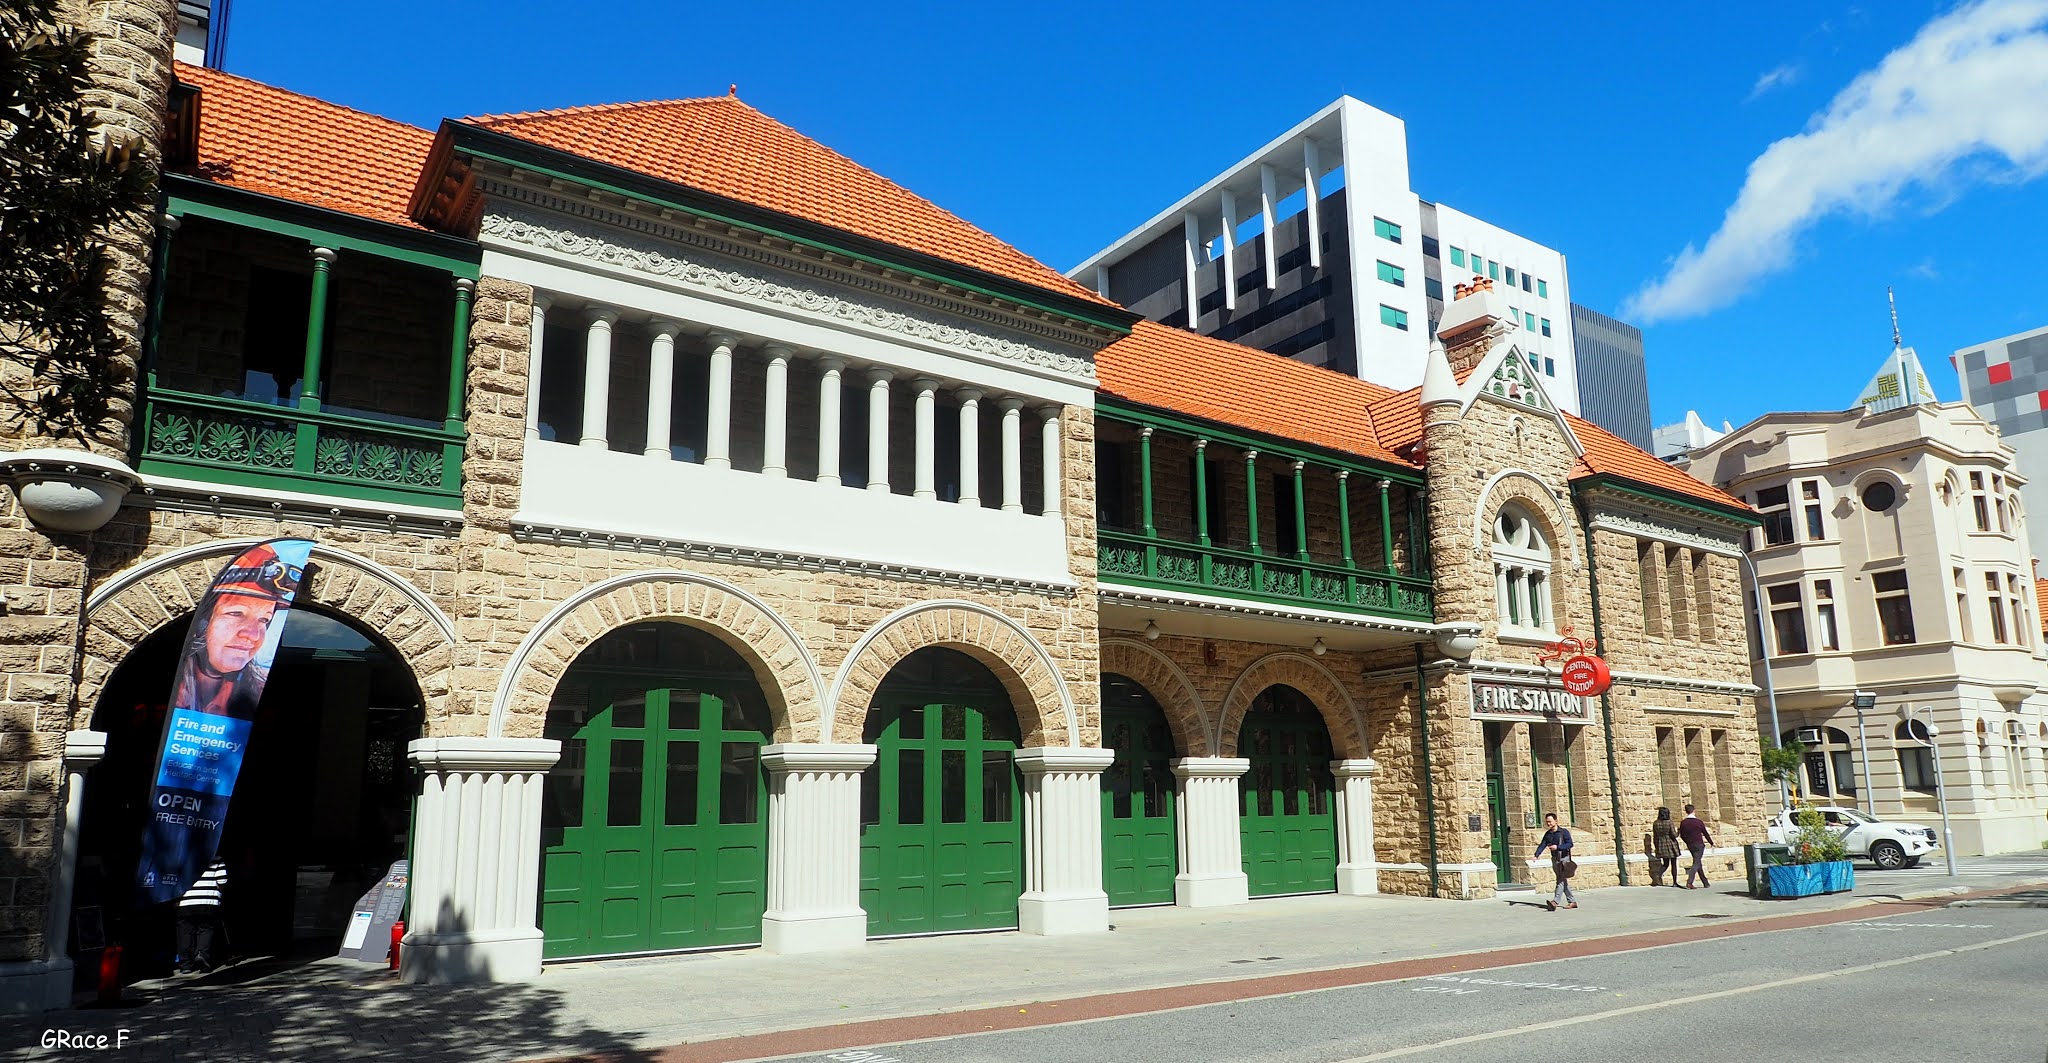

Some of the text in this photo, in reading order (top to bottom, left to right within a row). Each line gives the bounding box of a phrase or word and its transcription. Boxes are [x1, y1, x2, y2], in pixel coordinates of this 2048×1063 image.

[1565, 661, 1594, 674] CENTRAL
[1567, 678, 1594, 692] STATION
[1482, 686, 1582, 714] FIRE STATION
[176, 717, 226, 735] Fire and
[173, 730, 242, 753] Emergency
[170, 743, 220, 761] Services
[202, 766, 219, 775] and
[158, 793, 202, 812] OPEN
[155, 812, 220, 830] FREE ENTRY
